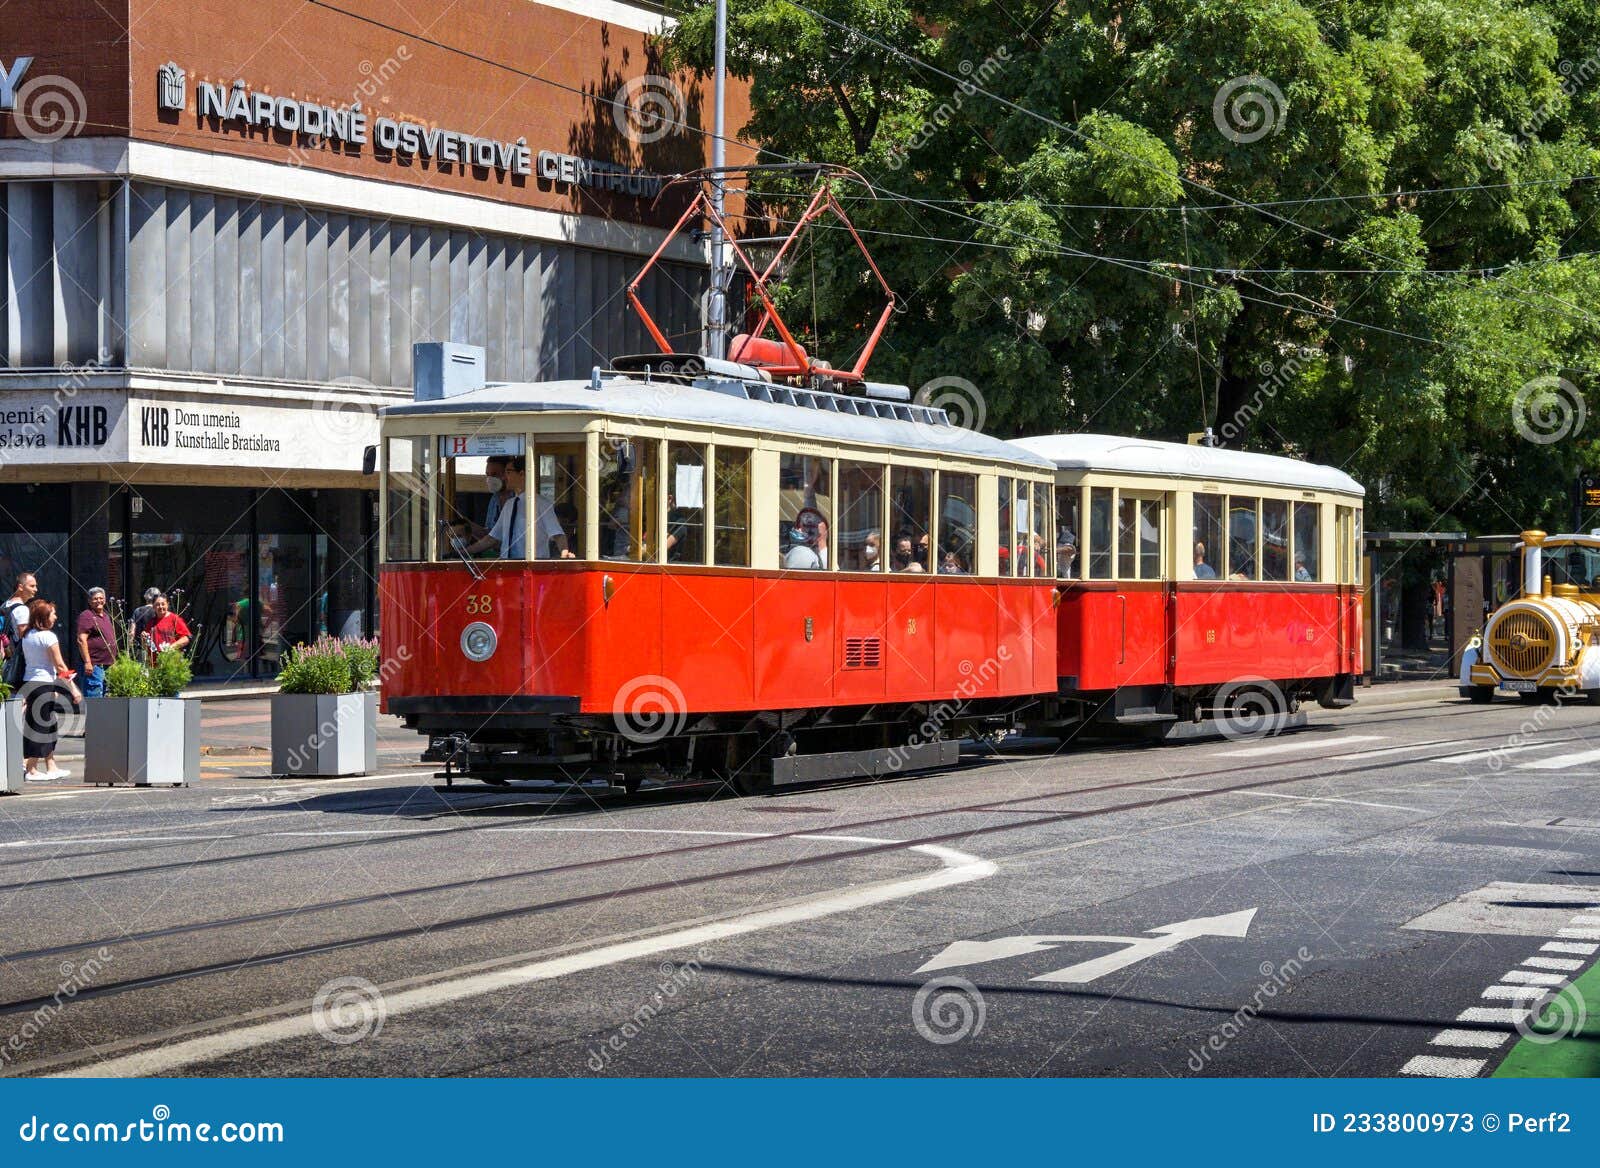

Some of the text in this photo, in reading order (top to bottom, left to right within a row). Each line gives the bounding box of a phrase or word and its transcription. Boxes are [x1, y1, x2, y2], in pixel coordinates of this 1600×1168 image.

[198, 79, 662, 198] NÁRODNÉ OSVETOVÉ CENTRUM
[57, 406, 108, 446] KHB
[141, 406, 169, 447] KHB
[175, 408, 240, 428] Dom umenia
[175, 431, 281, 452] Kunsthalle Bratislava
[452, 436, 467, 453] H
[466, 594, 492, 614] 38
